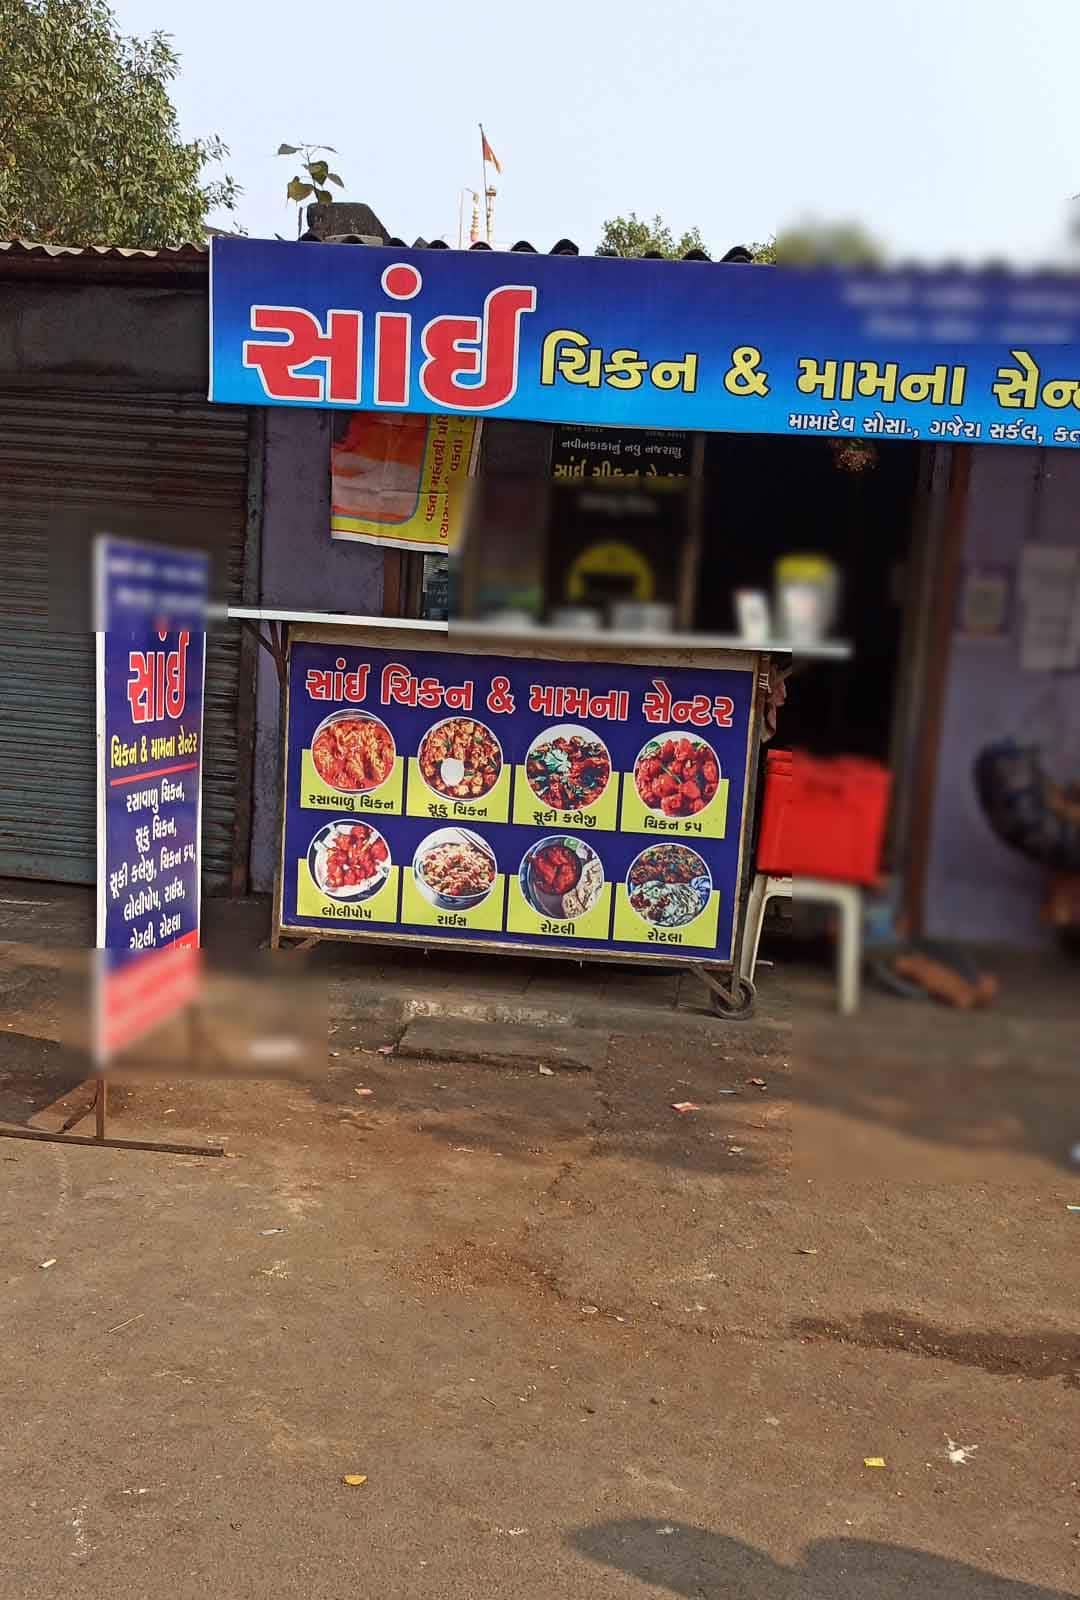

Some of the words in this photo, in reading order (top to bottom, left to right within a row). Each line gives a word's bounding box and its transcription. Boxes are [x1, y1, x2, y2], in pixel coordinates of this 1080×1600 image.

[243, 263, 537, 410] સાંઈ
[540, 328, 698, 393] ચિકન
[723, 345, 771, 398] &
[796, 358, 966, 406] મામના
[992, 349, 1080, 411] સેન્
[788, 409, 856, 432] મામાદેવ
[929, 415, 982, 438] ગજેરા
[306, 657, 371, 702] સાંઈ
[381, 663, 474, 711] ચિકન
[487, 676, 516, 714] &
[529, 684, 630, 721] મામના
[642, 680, 735, 727] સેન્ટર
[110, 734, 138, 769] ચિકન
[360, 795, 395, 810] ચિકન
[453, 802, 488, 817] ચિકન
[643, 816, 679, 831] ચિકન
[321, 903, 373, 919] લોલીપોપ
[540, 920, 576, 936] રોટલી
[647, 928, 683, 944] રોટલા
